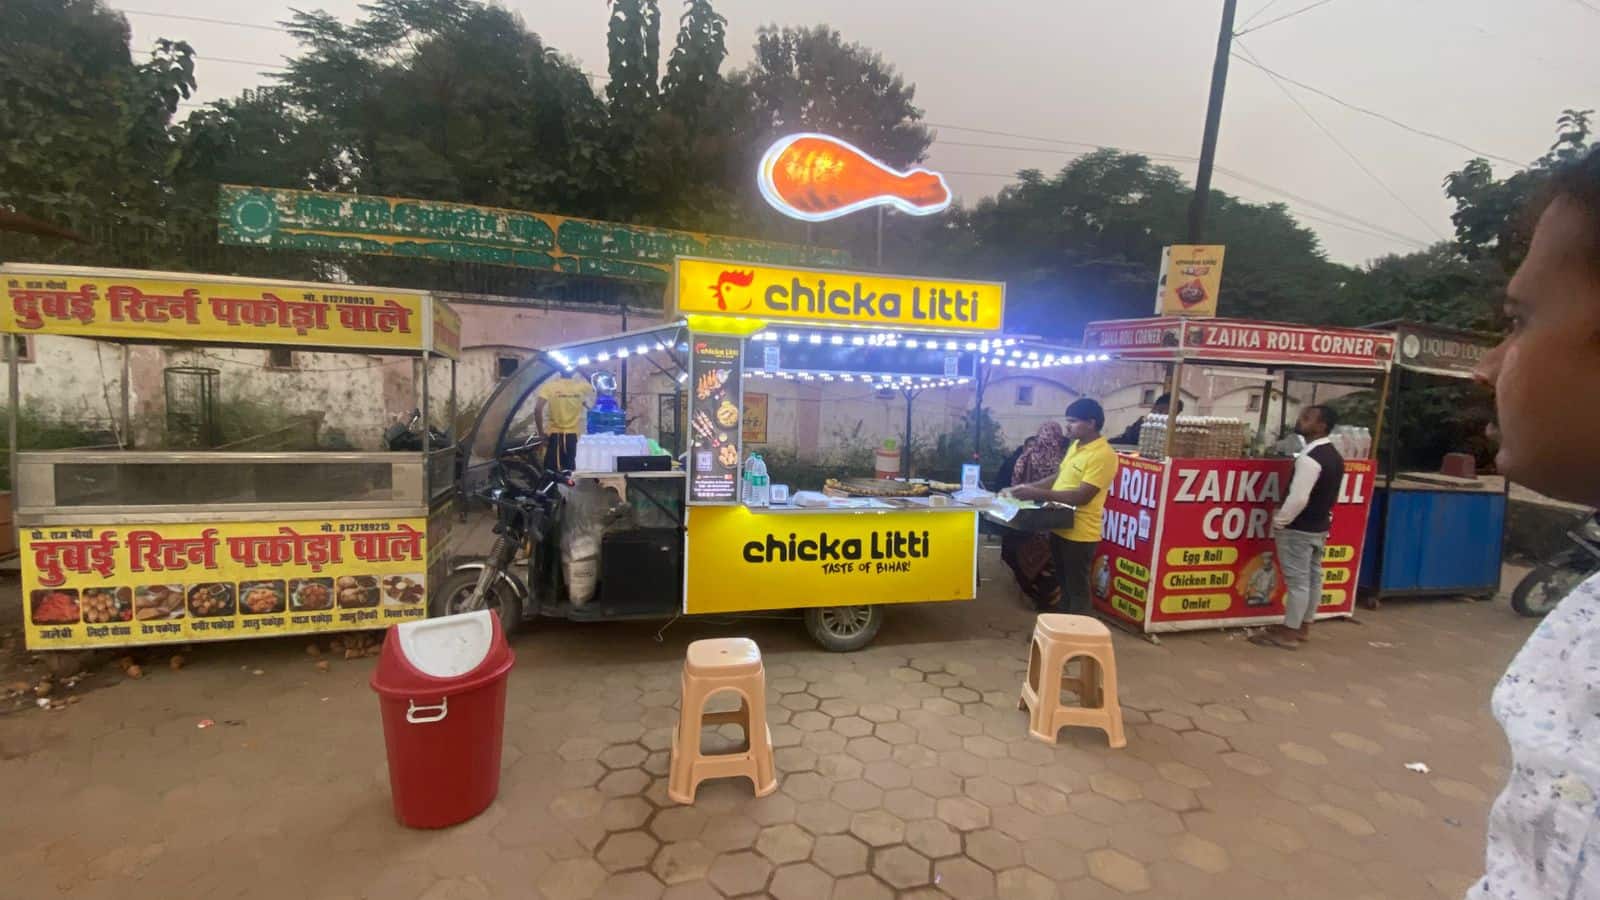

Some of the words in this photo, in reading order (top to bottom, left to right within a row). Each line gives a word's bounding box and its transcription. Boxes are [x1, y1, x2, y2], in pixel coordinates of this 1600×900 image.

[8, 284, 99, 330] दुबई
[105, 285, 201, 324] रिटर्न
[209, 292, 330, 336] पकोड़ा
[337, 300, 413, 333] वाले
[764, 277, 902, 318] chicka
[912, 286, 979, 322] Litti
[1206, 327, 1260, 348] ZAIKA
[1267, 331, 1305, 352] ROLL
[1312, 334, 1374, 357] CORNER
[1120, 467, 1157, 509] ROLL
[1174, 469, 1280, 503] ZAIKA
[1337, 473, 1365, 503] LL
[1101, 508, 1138, 551] RNER
[30, 531, 120, 587] दुबई
[125, 528, 220, 572] रिटर्न
[226, 527, 345, 573] पकोड़ा
[350, 524, 424, 562] वाले
[743, 532, 862, 563] chicka
[871, 530, 929, 559] Litti
[1183, 551, 1200, 565] Egg
[1203, 549, 1223, 562] Roll
[1329, 547, 1346, 558] Roll
[822, 562, 854, 575] TASTE
[859, 562, 872, 573] OF
[876, 560, 911, 574] BIHAR!
[1170, 572, 1206, 586] Chicken
[1209, 571, 1229, 585] Roll
[1326, 570, 1343, 581] Roll
[1181, 598, 1211, 609] Omlet
